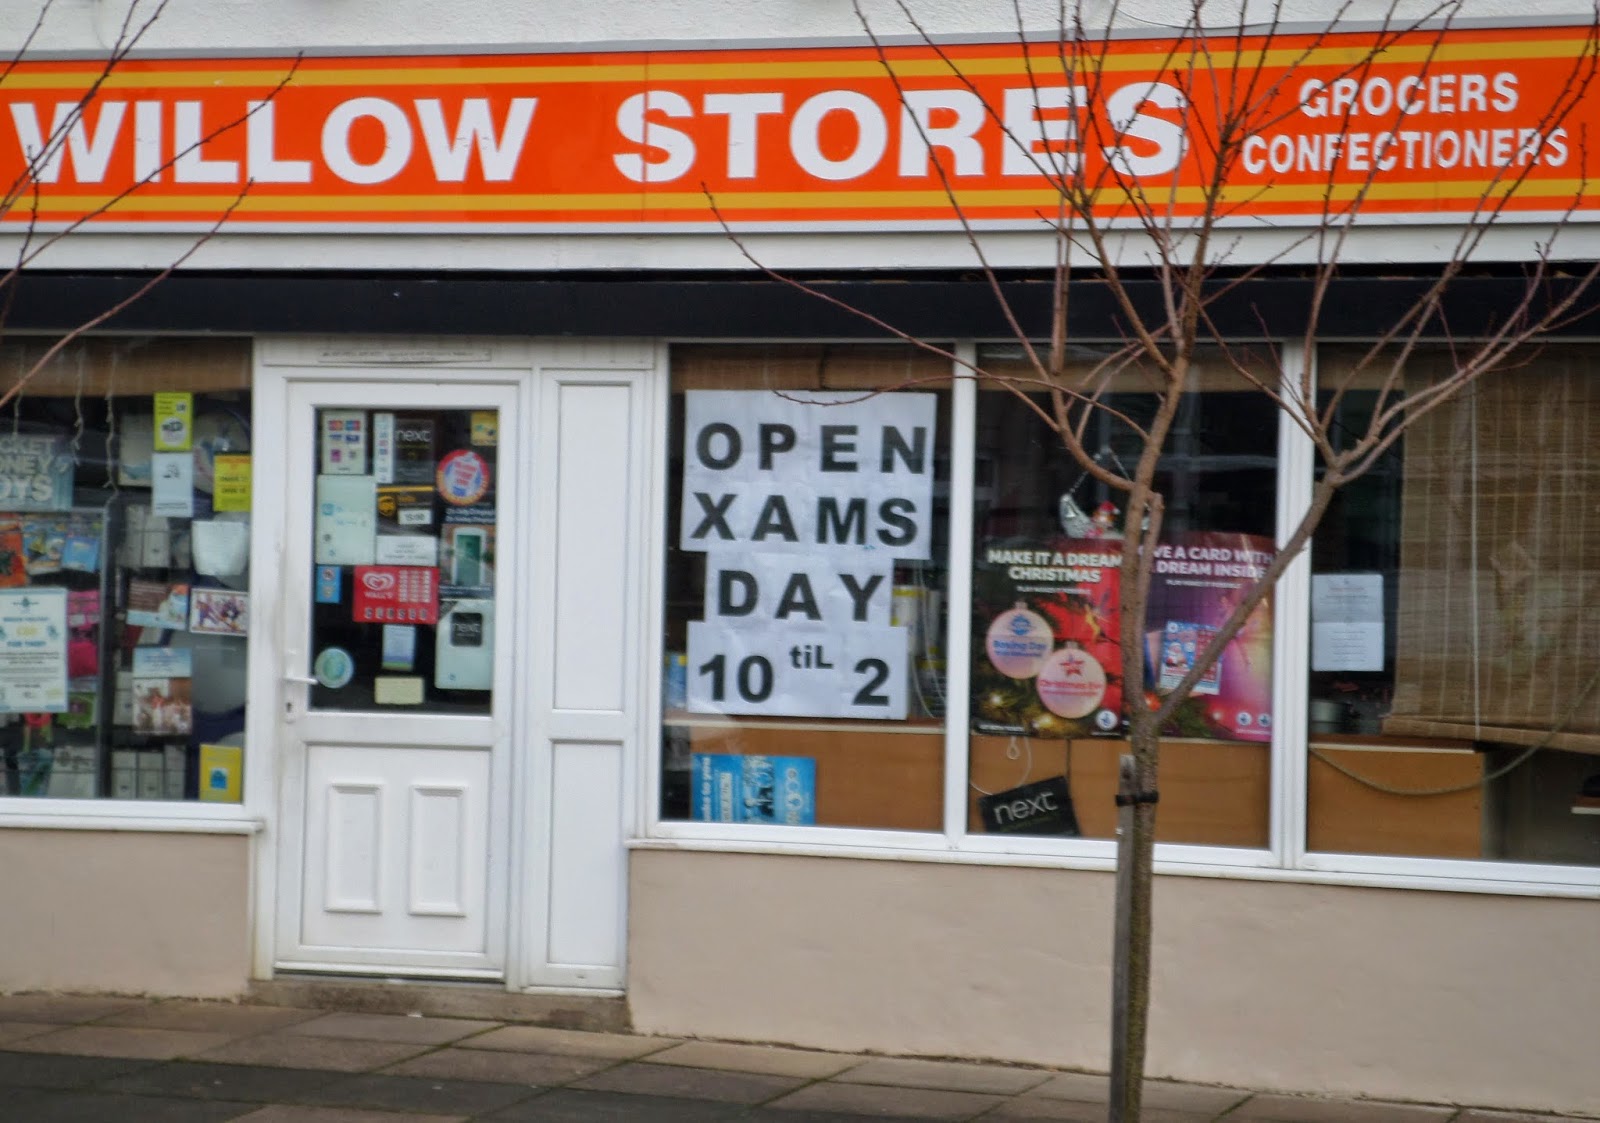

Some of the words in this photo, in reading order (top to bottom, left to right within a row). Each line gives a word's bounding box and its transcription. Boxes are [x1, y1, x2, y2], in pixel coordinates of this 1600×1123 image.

[1299, 72, 1520, 118] GROCERS
[9, 95, 538, 184] WILLOW
[612, 80, 1190, 184] STORES
[1241, 126, 1569, 174] CONFECTIONERS
[396, 429, 432, 442] next
[696, 422, 927, 474] OPEN
[0, 453, 54, 475] NEY
[691, 492, 918, 547] XAMS
[987, 549, 1032, 564] MAKE
[1034, 551, 1051, 565] IT
[1052, 552, 1065, 566] A
[1066, 553, 1123, 568] DREAM
[1156, 560, 1212, 576] DREAM
[1174, 546, 1186, 560] A
[1188, 547, 1232, 561] CARD
[1008, 565, 1102, 583] CHRISTMAS
[718, 570, 885, 622] DAY
[699, 654, 773, 704] 10
[853, 658, 890, 707] 2
[993, 791, 1059, 825] next
